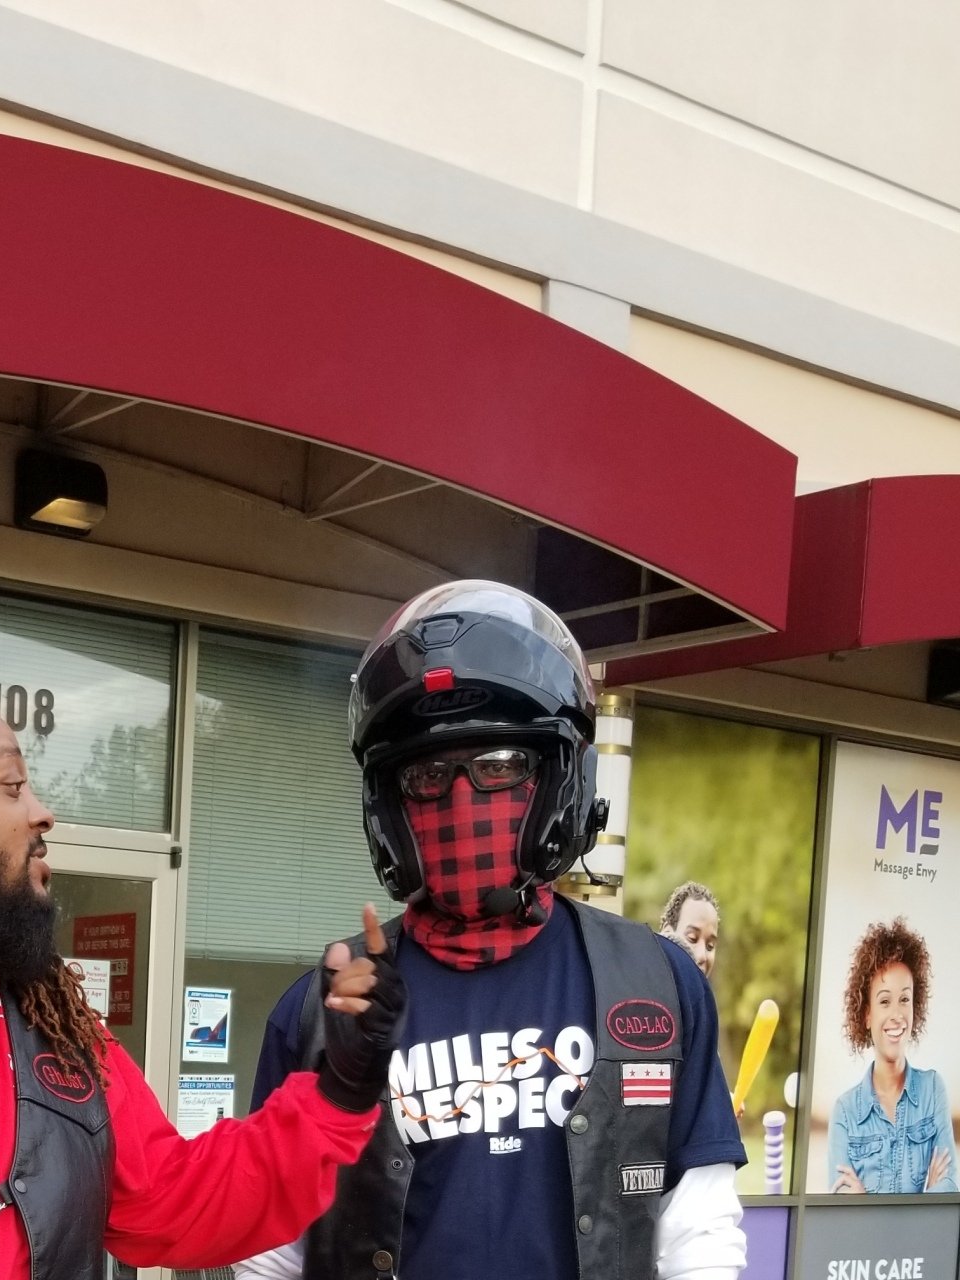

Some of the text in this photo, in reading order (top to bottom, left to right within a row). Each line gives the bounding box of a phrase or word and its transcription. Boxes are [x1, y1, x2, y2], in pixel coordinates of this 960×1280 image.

[875, 783, 943, 853] ME
[874, 857, 938, 883] Massage Envy
[615, 1016, 670, 1034] CAD-LAC
[388, 1027, 544, 1099] MILES
[489, 1136, 522, 1152] Ride
[874, 1257, 925, 1280] CARE
